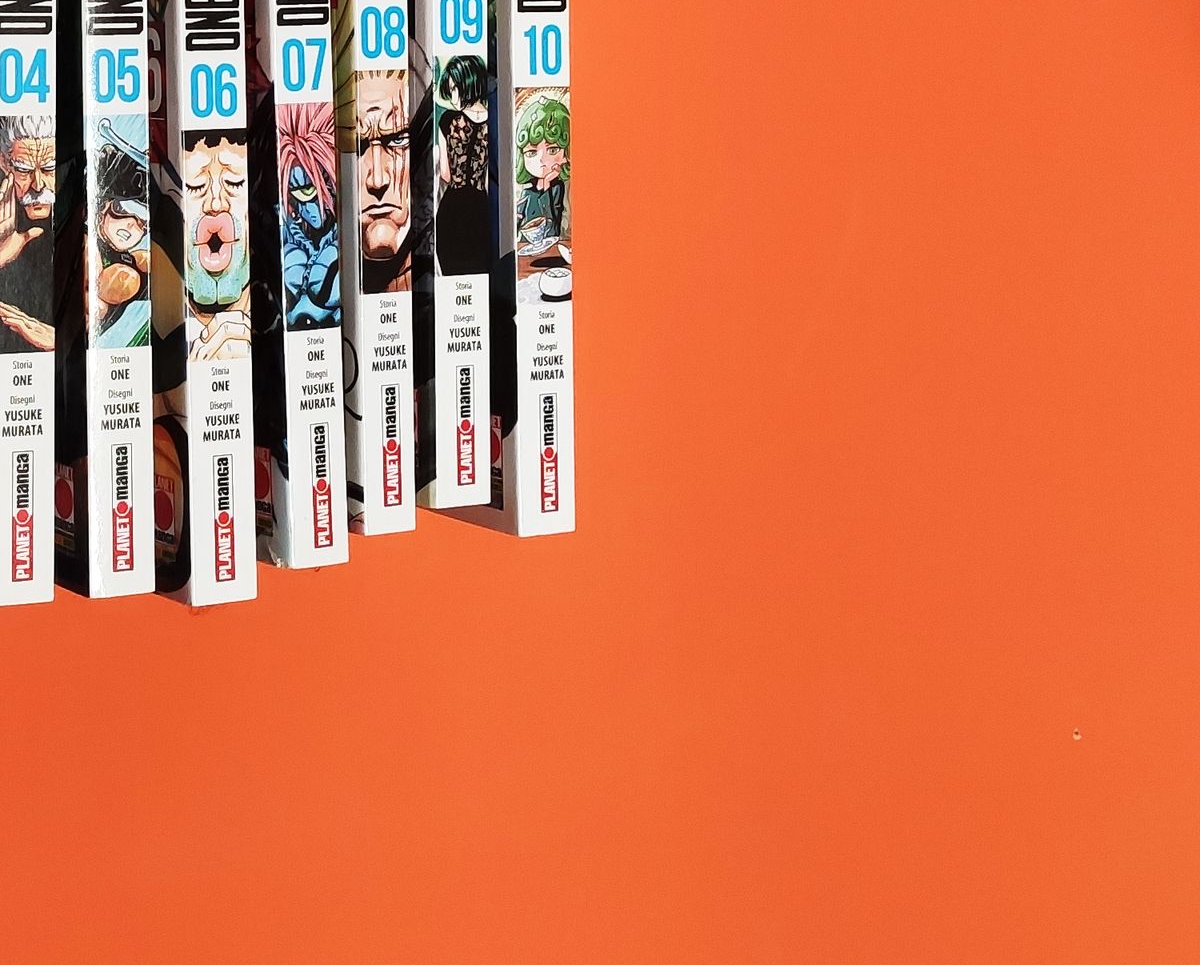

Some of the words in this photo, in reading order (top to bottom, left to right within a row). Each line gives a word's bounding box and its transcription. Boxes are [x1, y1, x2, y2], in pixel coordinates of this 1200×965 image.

[360, 6, 405, 59] 08
[524, 24, 562, 75] 10
[281, 38, 327, 91] 07
[0, 48, 50, 103] 04
[93, 48, 141, 103] 05
[190, 63, 238, 118] 06
[455, 281, 473, 291] Storia
[379, 299, 397, 309] Storia
[455, 294, 473, 306] ONE
[380, 313, 398, 324] ONE
[454, 313, 476, 323] Disegni
[538, 310, 555, 320] Storia
[449, 326, 481, 339] YUSUKE
[539, 323, 556, 335] ONE
[306, 336, 325, 346] Storia
[378, 331, 400, 342] Disegni
[373, 344, 407, 358] YUSUKE
[447, 340, 482, 354] MURATA
[537, 342, 558, 352] Disegni
[110, 354, 130, 364] Storia
[307, 349, 325, 362] ONE
[532, 355, 564, 367] YUSUKE
[12, 360, 32, 369] Storia
[211, 366, 230, 376] Storia
[371, 359, 407, 372] MURATA
[12, 375, 32, 386] ONE
[110, 368, 130, 380] ONE
[305, 369, 328, 381] Disegni
[530, 368, 565, 381] MURATA
[211, 381, 230, 392] ONE
[301, 382, 335, 396] YUSUKE
[10, 395, 35, 406] Disegni
[108, 388, 133, 400] Disegni
[103, 402, 140, 415] YUSUKE
[209, 400, 233, 411] Disegni
[299, 396, 336, 411] MURATA
[4, 409, 43, 422] YUSUKE
[205, 413, 240, 427] YUSUKE
[1, 424, 43, 437] MURATA
[100, 417, 141, 431] MURATA
[202, 429, 241, 442] MURATA
[460, 433, 473, 484] PLANET
[387, 452, 400, 505] PLANET
[544, 460, 556, 511] PLANET
[316, 493, 330, 547] PLANET
[116, 515, 130, 570] PLANET
[15, 524, 30, 580] PLANET
[217, 525, 231, 580] PLANET
